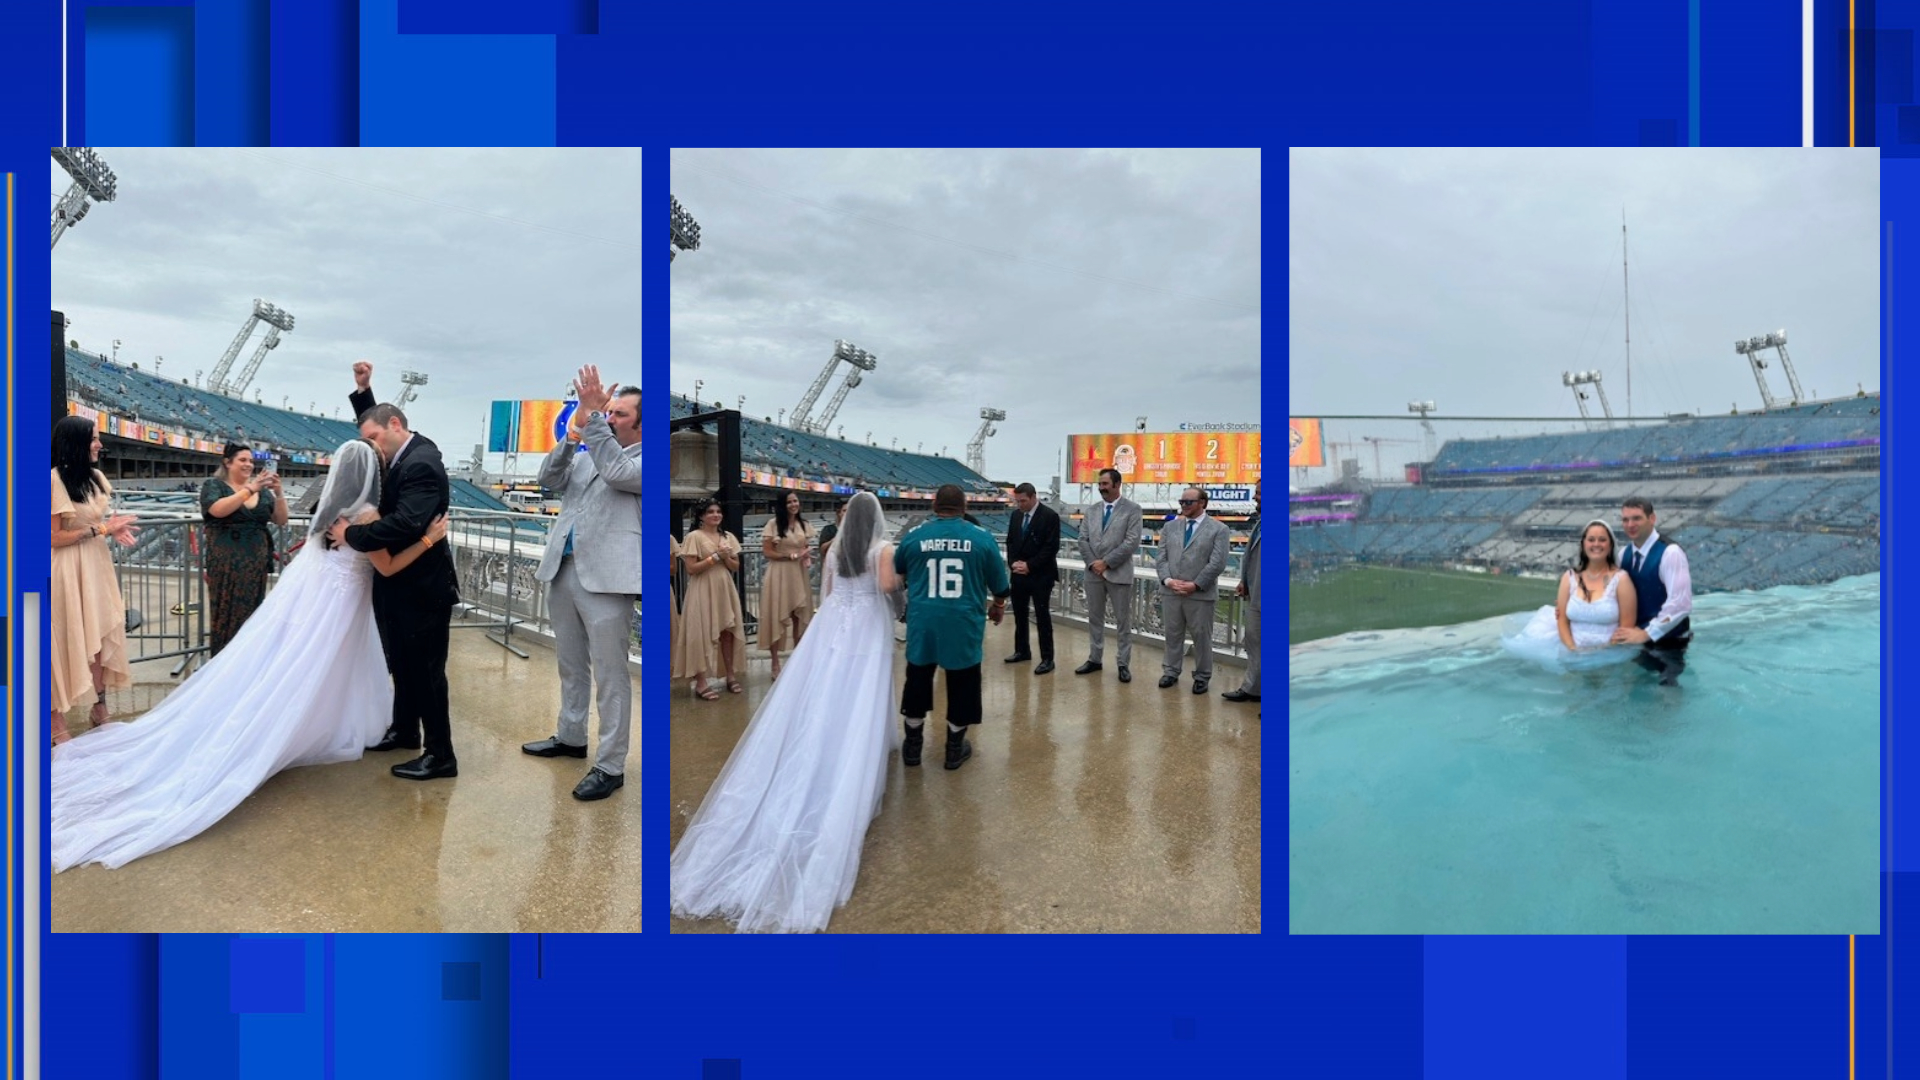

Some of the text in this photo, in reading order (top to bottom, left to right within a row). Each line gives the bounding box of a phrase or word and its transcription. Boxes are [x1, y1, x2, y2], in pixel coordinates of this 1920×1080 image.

[1187, 422, 1261, 430] EverBank Stadium
[1158, 439, 1166, 460] 1
[1206, 439, 1219, 460] 2
[1212, 490, 1247, 499] LIGHT
[919, 538, 972, 553] WARFIELD
[926, 558, 964, 599] 16
